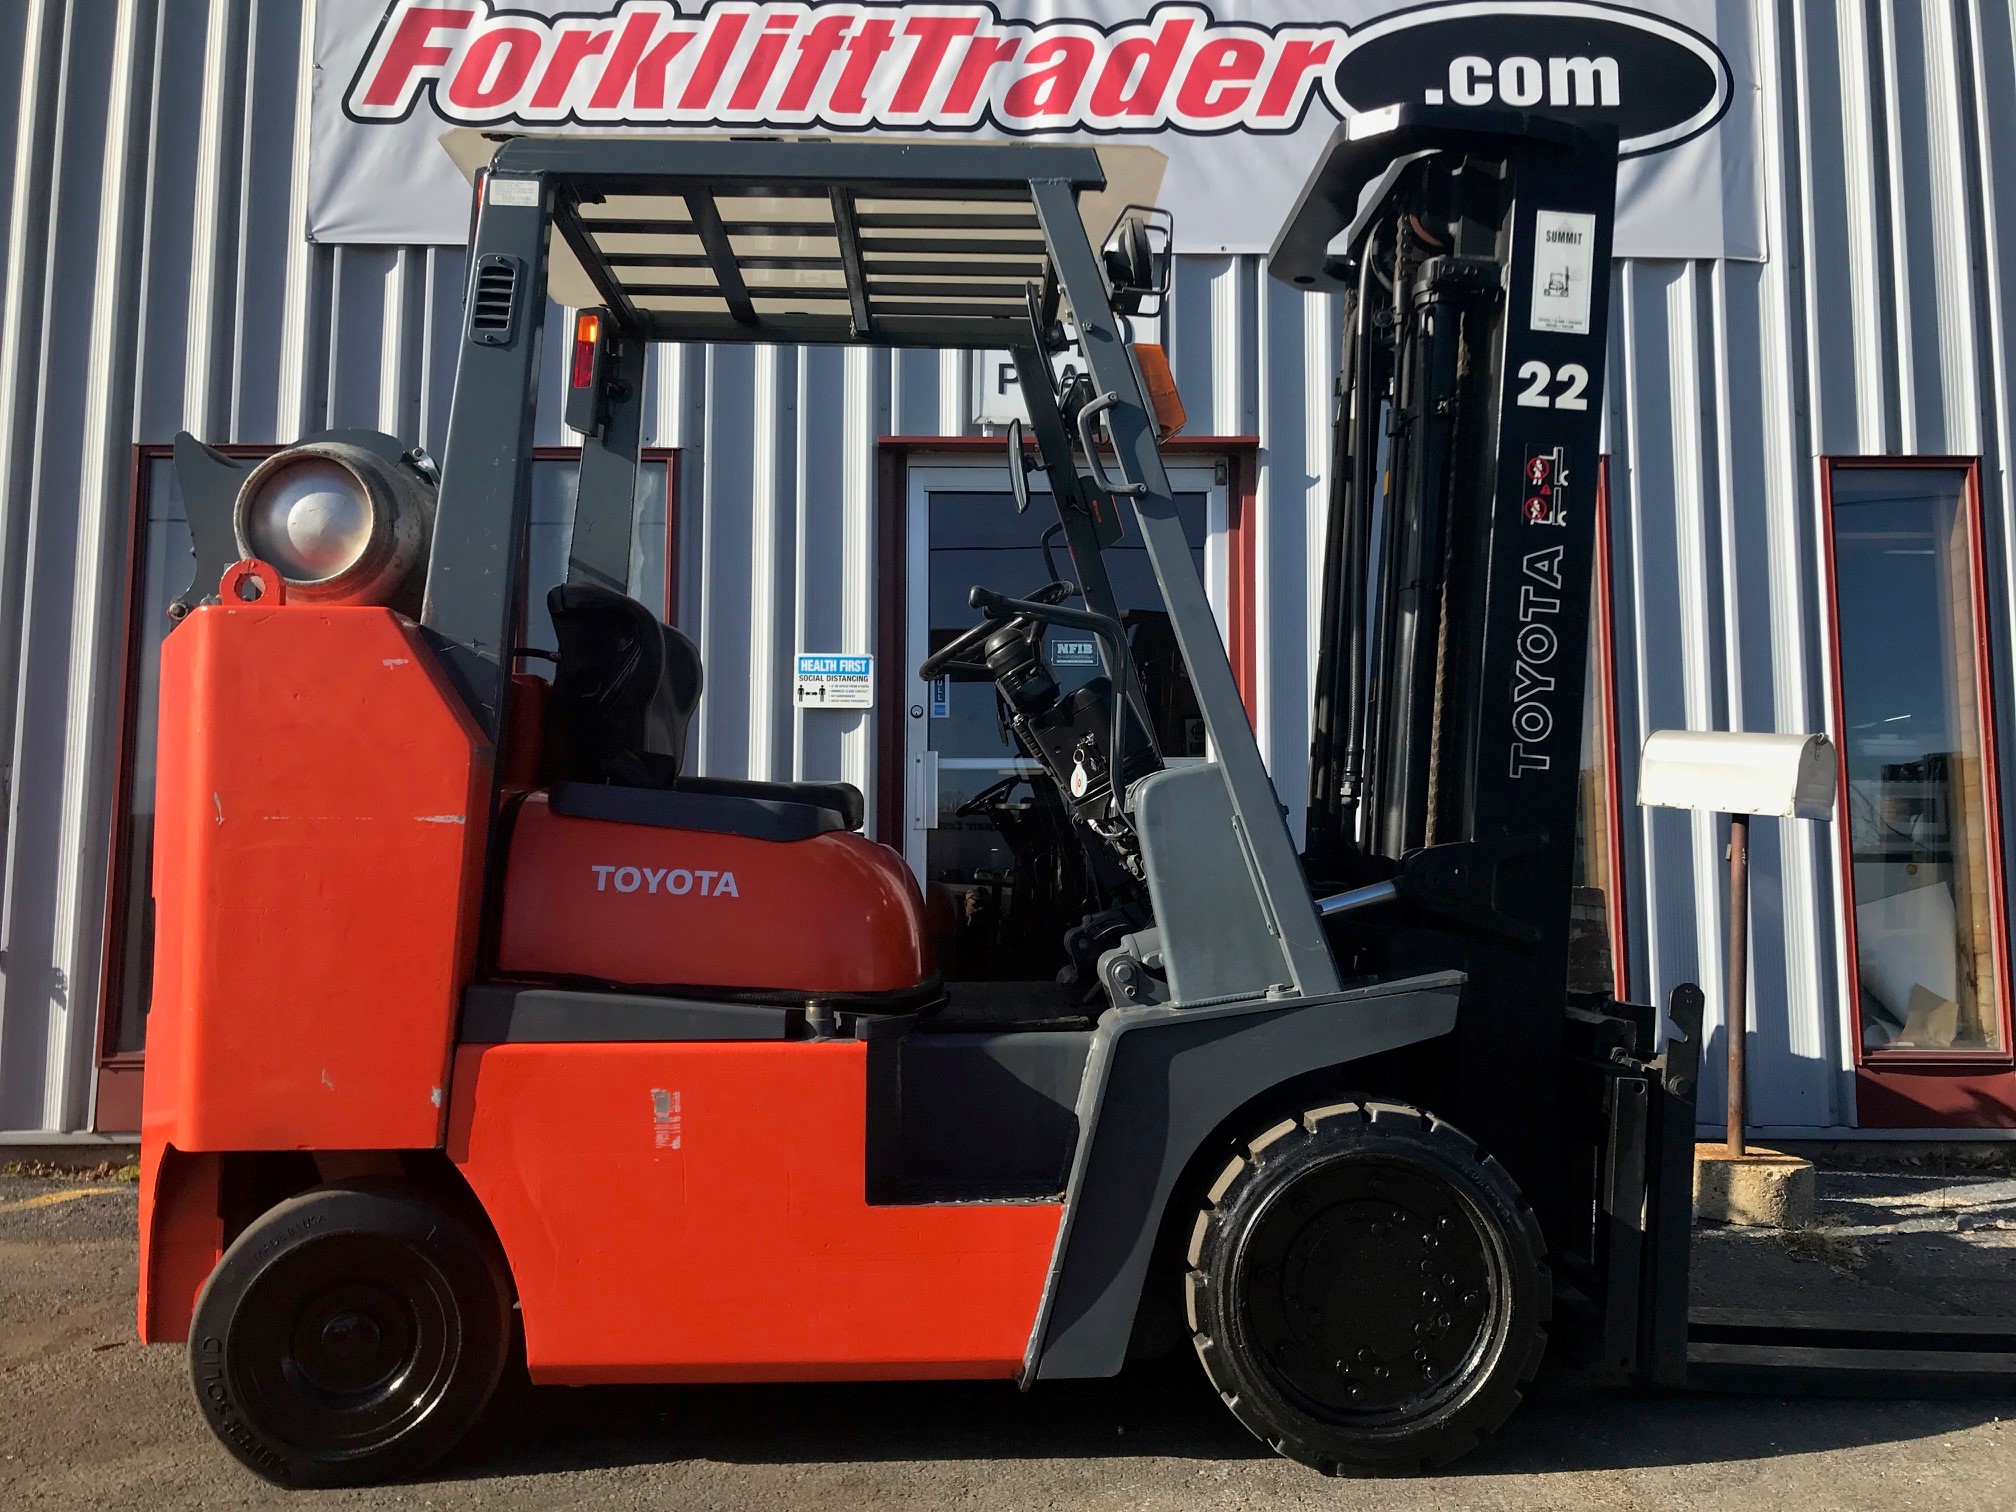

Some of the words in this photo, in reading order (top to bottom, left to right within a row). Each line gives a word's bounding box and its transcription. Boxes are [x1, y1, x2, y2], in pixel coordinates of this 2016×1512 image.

[362, 7, 1337, 119] ForkliftTrader
[1425, 53, 1621, 107] .com
[1545, 230, 1583, 245] SUMMIT
[1516, 360, 1589, 411] 22
[1057, 643, 1093, 654] NFIB
[1508, 545, 1564, 779] TOYOTA
[798, 674, 825, 682] SOCIAL
[826, 675, 869, 683] DISTANCING
[800, 659, 837, 672] HEALTH
[840, 659, 867, 673] FIRST
[936, 678, 944, 702] ULL
[591, 865, 739, 898] TOYOTA
[202, 1336, 235, 1416] SOLID
